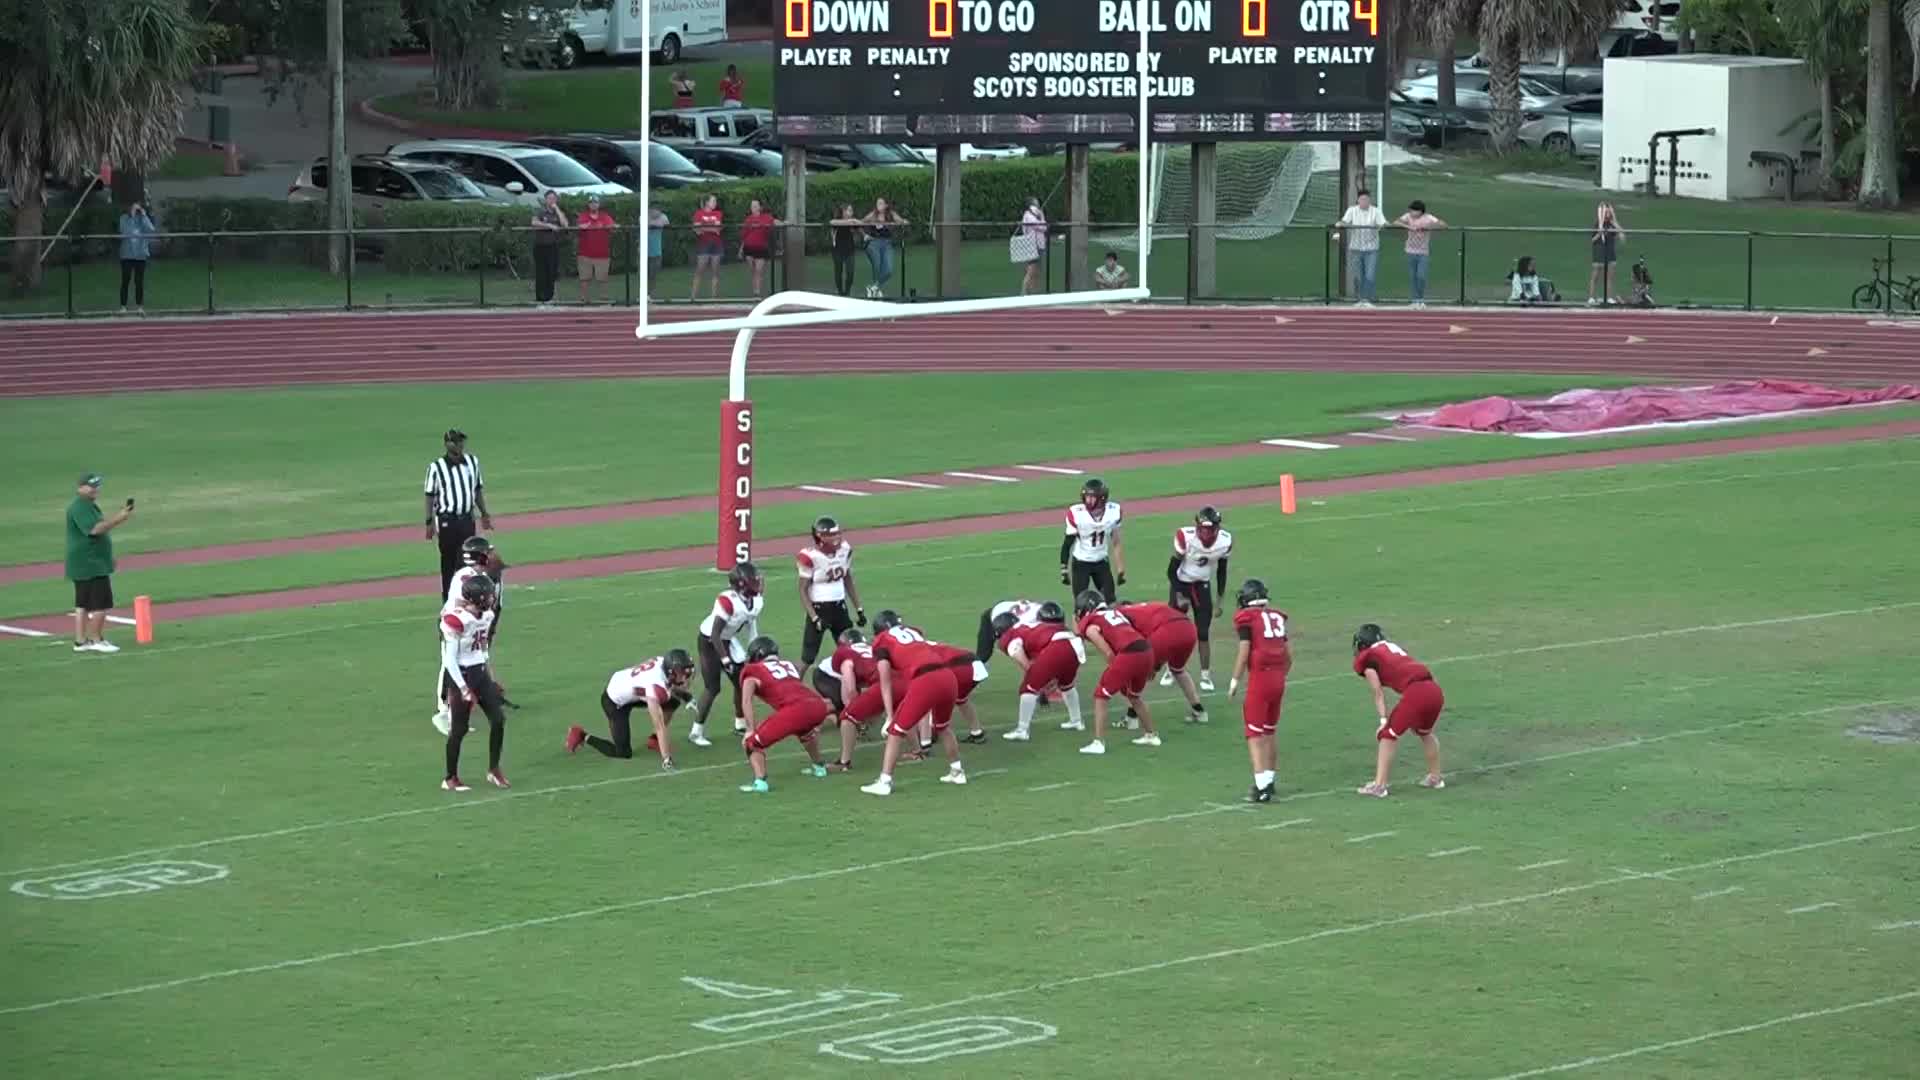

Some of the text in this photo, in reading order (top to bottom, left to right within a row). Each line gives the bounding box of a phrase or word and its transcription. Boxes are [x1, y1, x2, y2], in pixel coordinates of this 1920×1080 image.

[785, 0, 809, 37] 0
[813, 0, 889, 32] DOWN
[929, 0, 953, 37] 0
[958, 0, 1034, 32] TO GO
[1175, 0, 1211, 32] ON
[1243, 0, 1266, 37] 0
[1299, 0, 1350, 32] QTR
[1354, 0, 1378, 36] 4
[781, 47, 950, 66] PLAYER PENALTY
[1008, 51, 1130, 73] SPONSORED
[1208, 46, 1375, 64] PLAYER PENALTY
[972, 75, 1195, 98] SCOTS BOOSTER CLUB
[734, 409, 752, 564] SCOTS
[1090, 530, 1105, 548] 11
[1260, 611, 1286, 639] 13
[763, 660, 800, 680] 53
